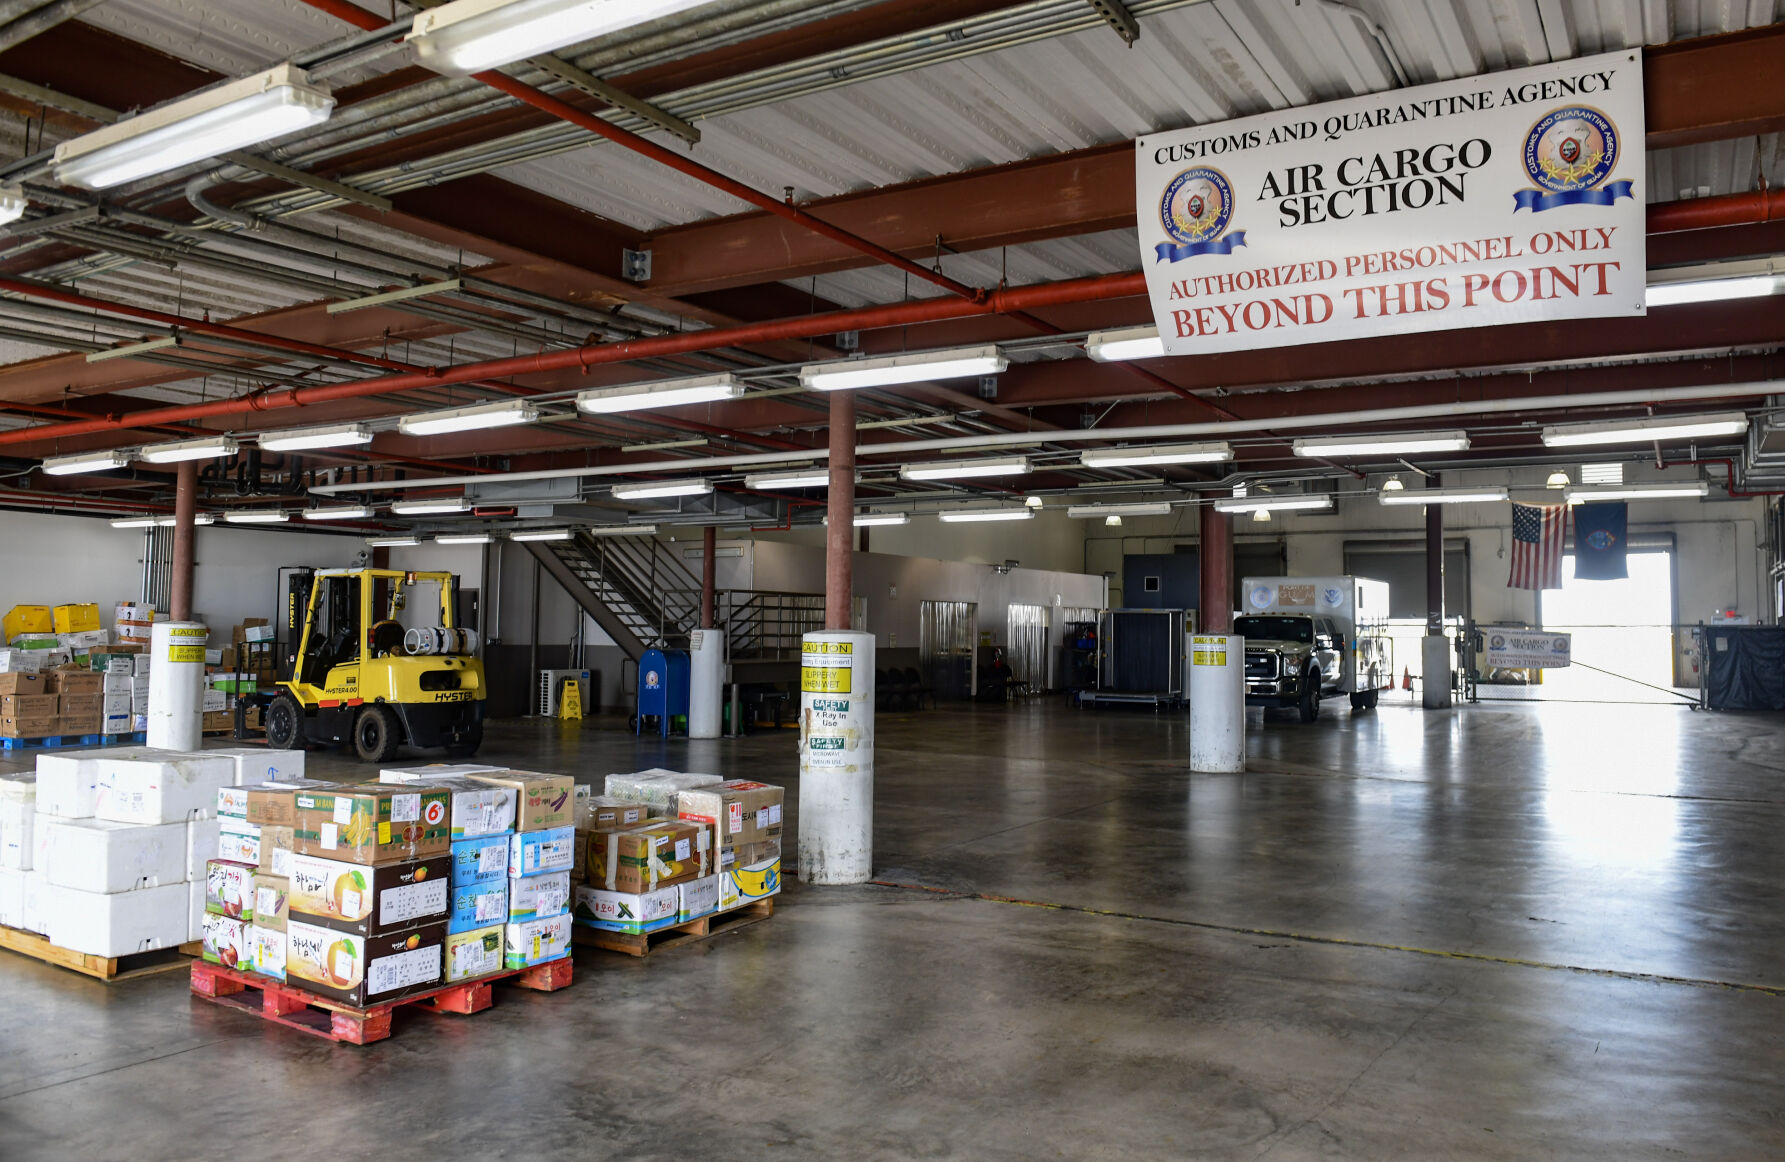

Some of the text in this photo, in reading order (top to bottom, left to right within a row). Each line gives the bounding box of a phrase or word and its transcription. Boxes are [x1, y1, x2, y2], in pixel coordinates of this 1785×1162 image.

[1154, 70, 1617, 165] CUSTOMS AND QUARANTINE AGENCY
[1527, 109, 1614, 174] CUSTOMS AND QUARANTINE AGENCY
[1257, 138, 1492, 201] AIR CARGO
[1163, 170, 1230, 229] CUSTOMS AND QUARANTINE AGENCY
[1279, 172, 1468, 228] SECTION
[1169, 226, 1618, 300] AUTHORIZED PERSONNEL ONLY
[1171, 261, 1621, 338] BEYOND THIS POINT
[801, 643, 848, 654] CAUTION
[814, 657, 850, 667] Equipment
[804, 670, 838, 680] SLIPPERY
[821, 680, 841, 689] WET
[434, 691, 473, 702] HYSTER
[814, 700, 848, 708] SAFETY
[838, 711, 847, 720] In
[822, 719, 838, 727] Use
[811, 738, 844, 746] SAFETY
[457, 848, 479, 865] 순천
[456, 893, 478, 911] 순천
